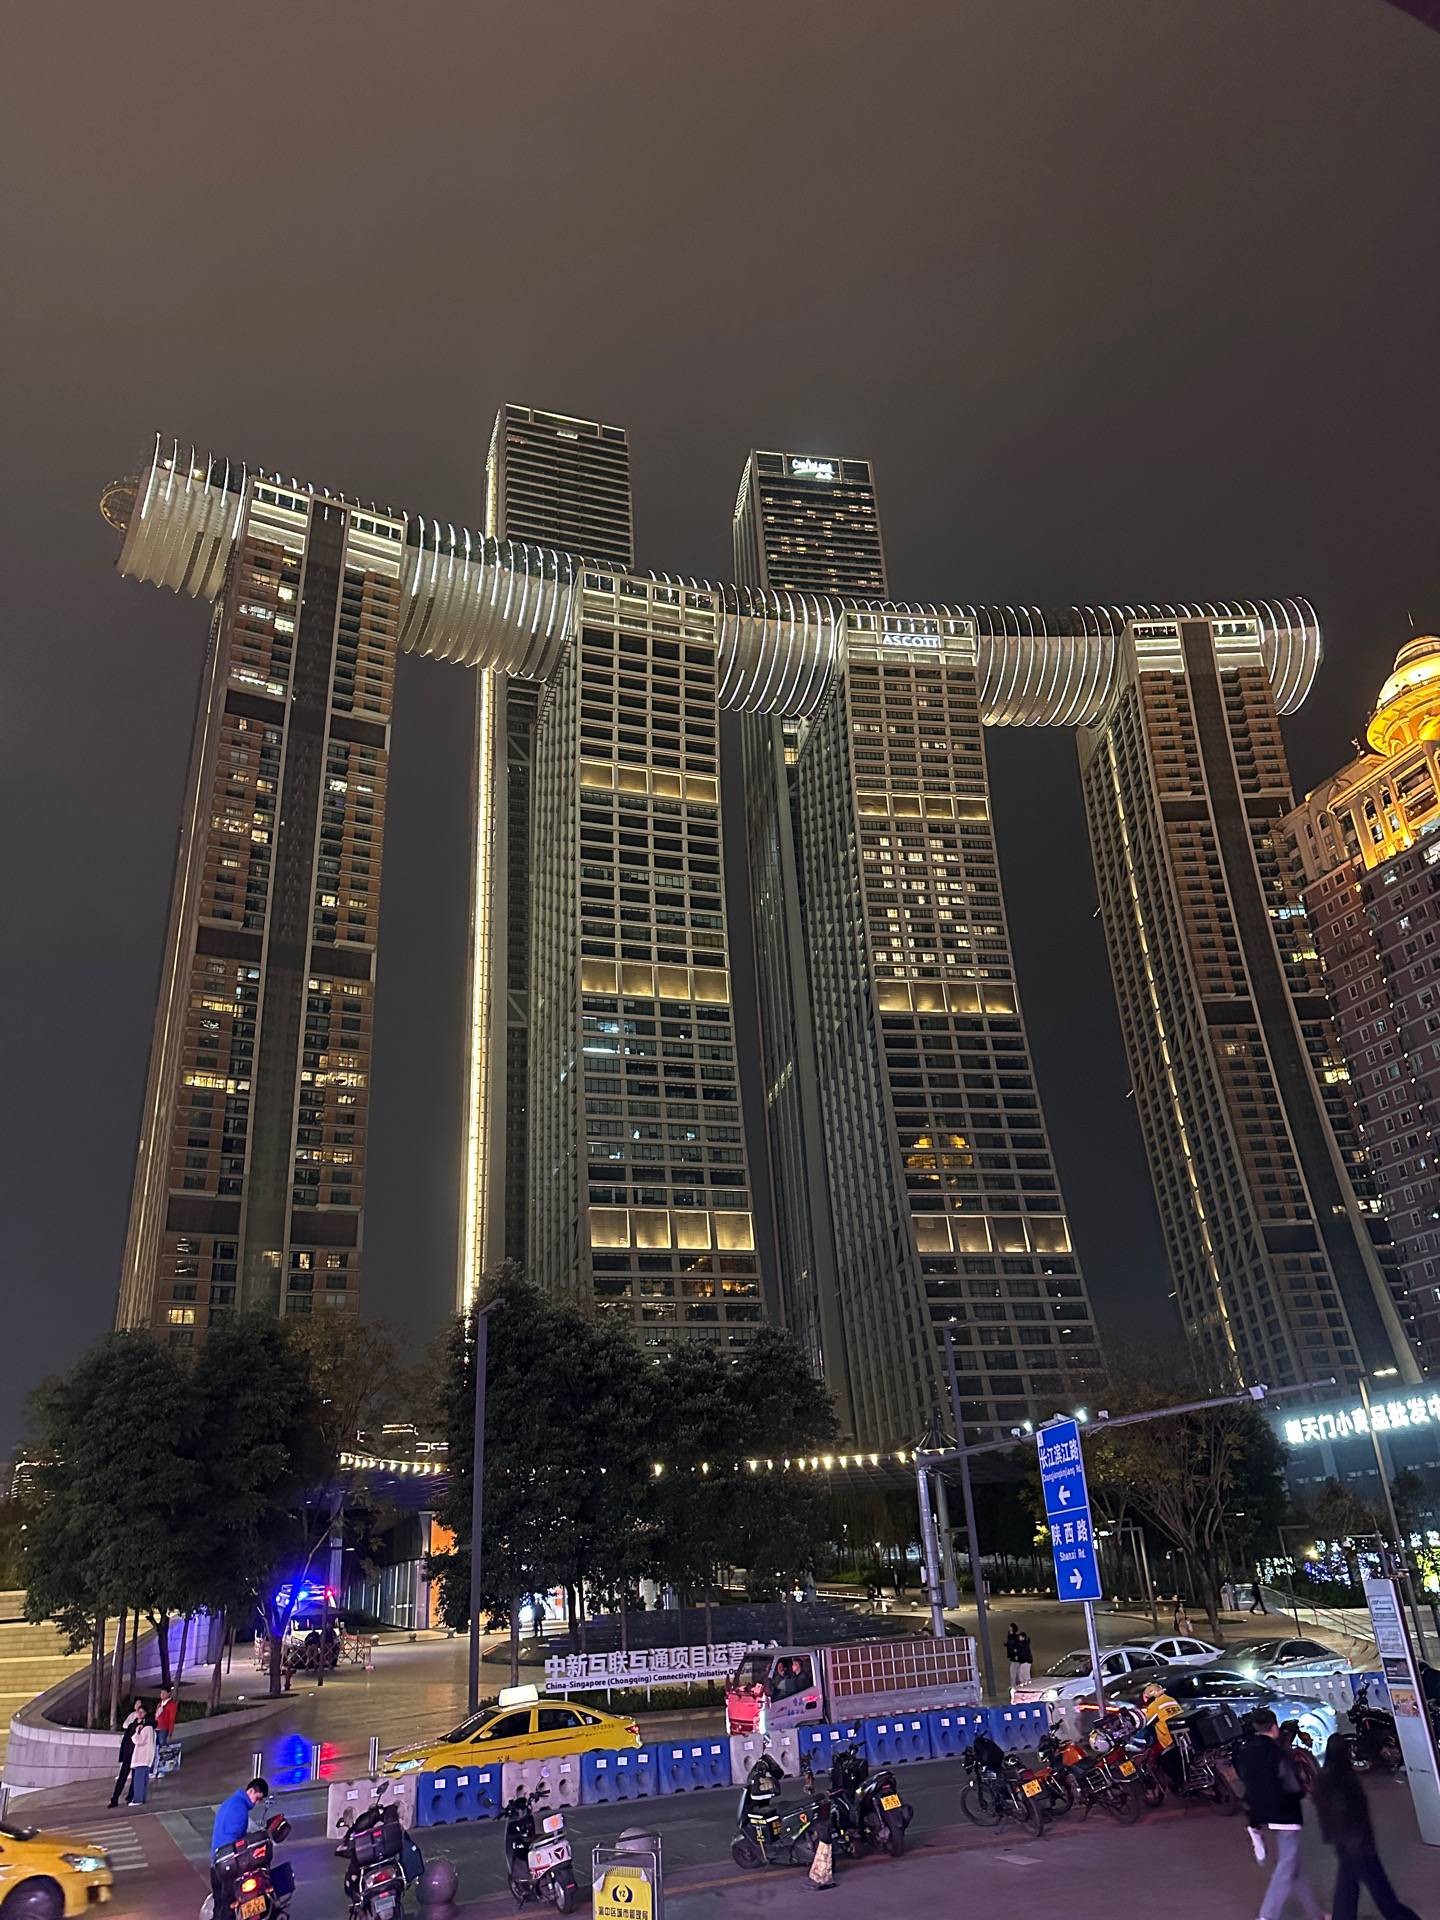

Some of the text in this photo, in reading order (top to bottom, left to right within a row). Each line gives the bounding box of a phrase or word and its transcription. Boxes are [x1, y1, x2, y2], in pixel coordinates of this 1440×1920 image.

[883, 634, 938, 648] ASCOTT
[1040, 1438, 1079, 1469] 长江滨江路
[1051, 1519, 1088, 1547] 陕西路
[545, 1679, 606, 1690] China-Singapore
[607, 1675, 652, 1687] (Chongqing)
[653, 1671, 697, 1681] Connectivity
[697, 1667, 728, 1678] Initiative
